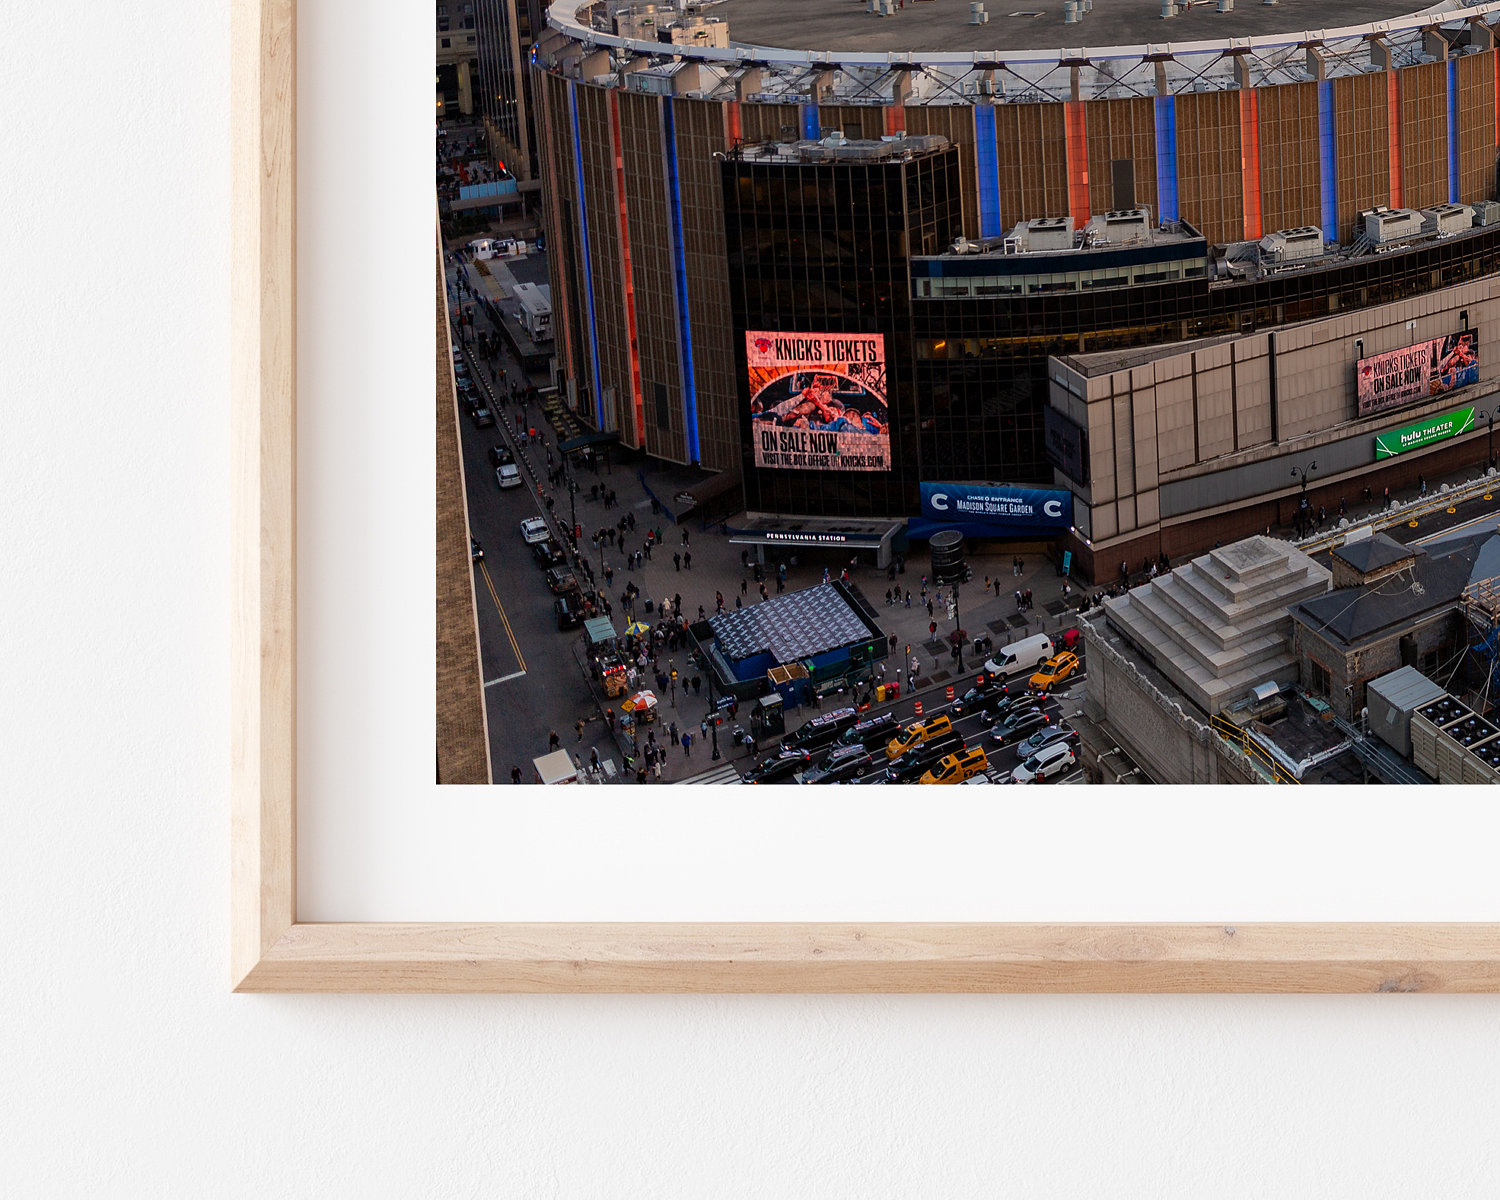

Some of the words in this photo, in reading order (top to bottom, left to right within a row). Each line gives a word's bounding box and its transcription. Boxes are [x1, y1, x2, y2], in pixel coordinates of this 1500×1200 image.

[775, 339, 822, 361] KNICKS
[824, 340, 877, 361] TICKETS
[1373, 356, 1399, 378] KNICKS
[1400, 350, 1426, 371] TICKETS
[1373, 377, 1385, 395] ON
[1385, 372, 1403, 391] SALE
[1404, 366, 1421, 386] NOW
[761, 430, 778, 451] ON
[780, 431, 808, 453] SALE
[809, 433, 838, 454] NOW
[1401, 431, 1422, 443] hulu
[1423, 421, 1453, 436] THEATER
[762, 452, 779, 465] VISIT
[781, 453, 793, 466] THE
[793, 454, 807, 467] BOX
[808, 454, 830, 467] OFFICE
[840, 455, 884, 468] KNICKS.COM
[766, 533, 817, 541] PENNSYLVANIA
